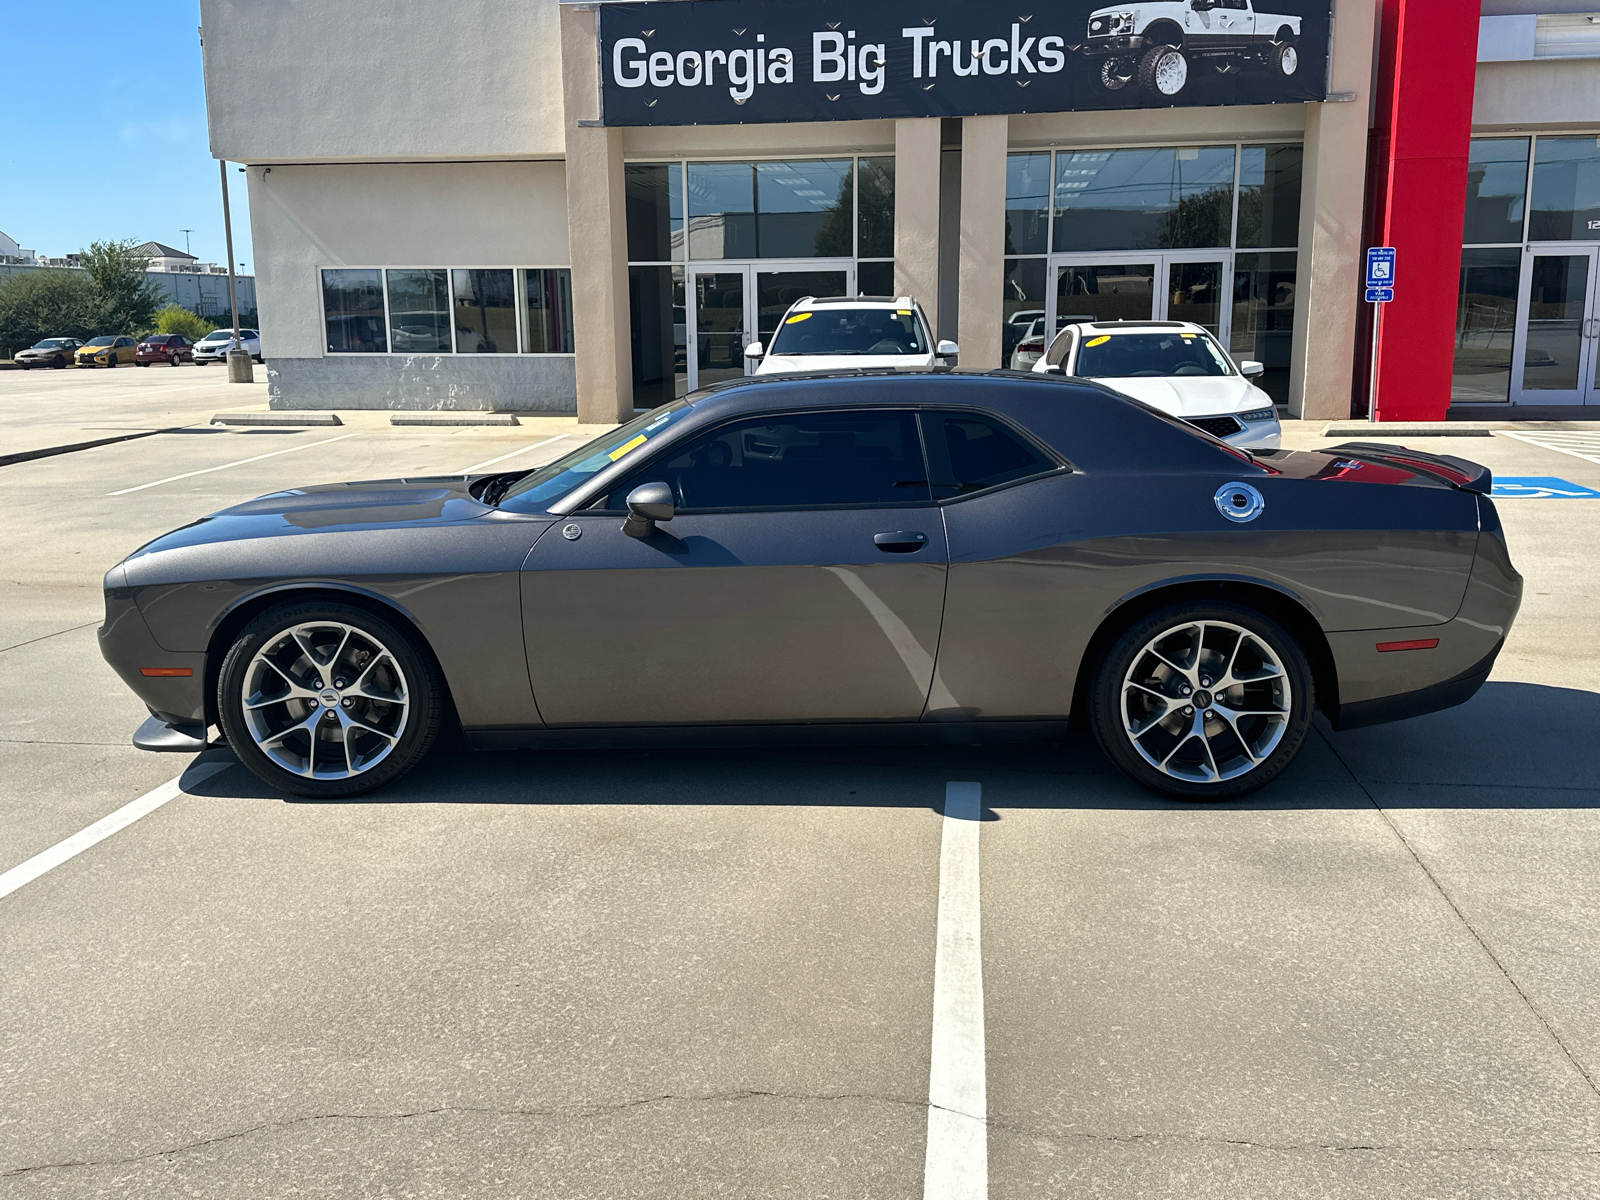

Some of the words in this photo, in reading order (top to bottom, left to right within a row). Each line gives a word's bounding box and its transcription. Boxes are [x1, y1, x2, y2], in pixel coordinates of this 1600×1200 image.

[613, 34, 794, 100] Georgia
[812, 30, 886, 95] Big
[902, 23, 1066, 78] Trucks
